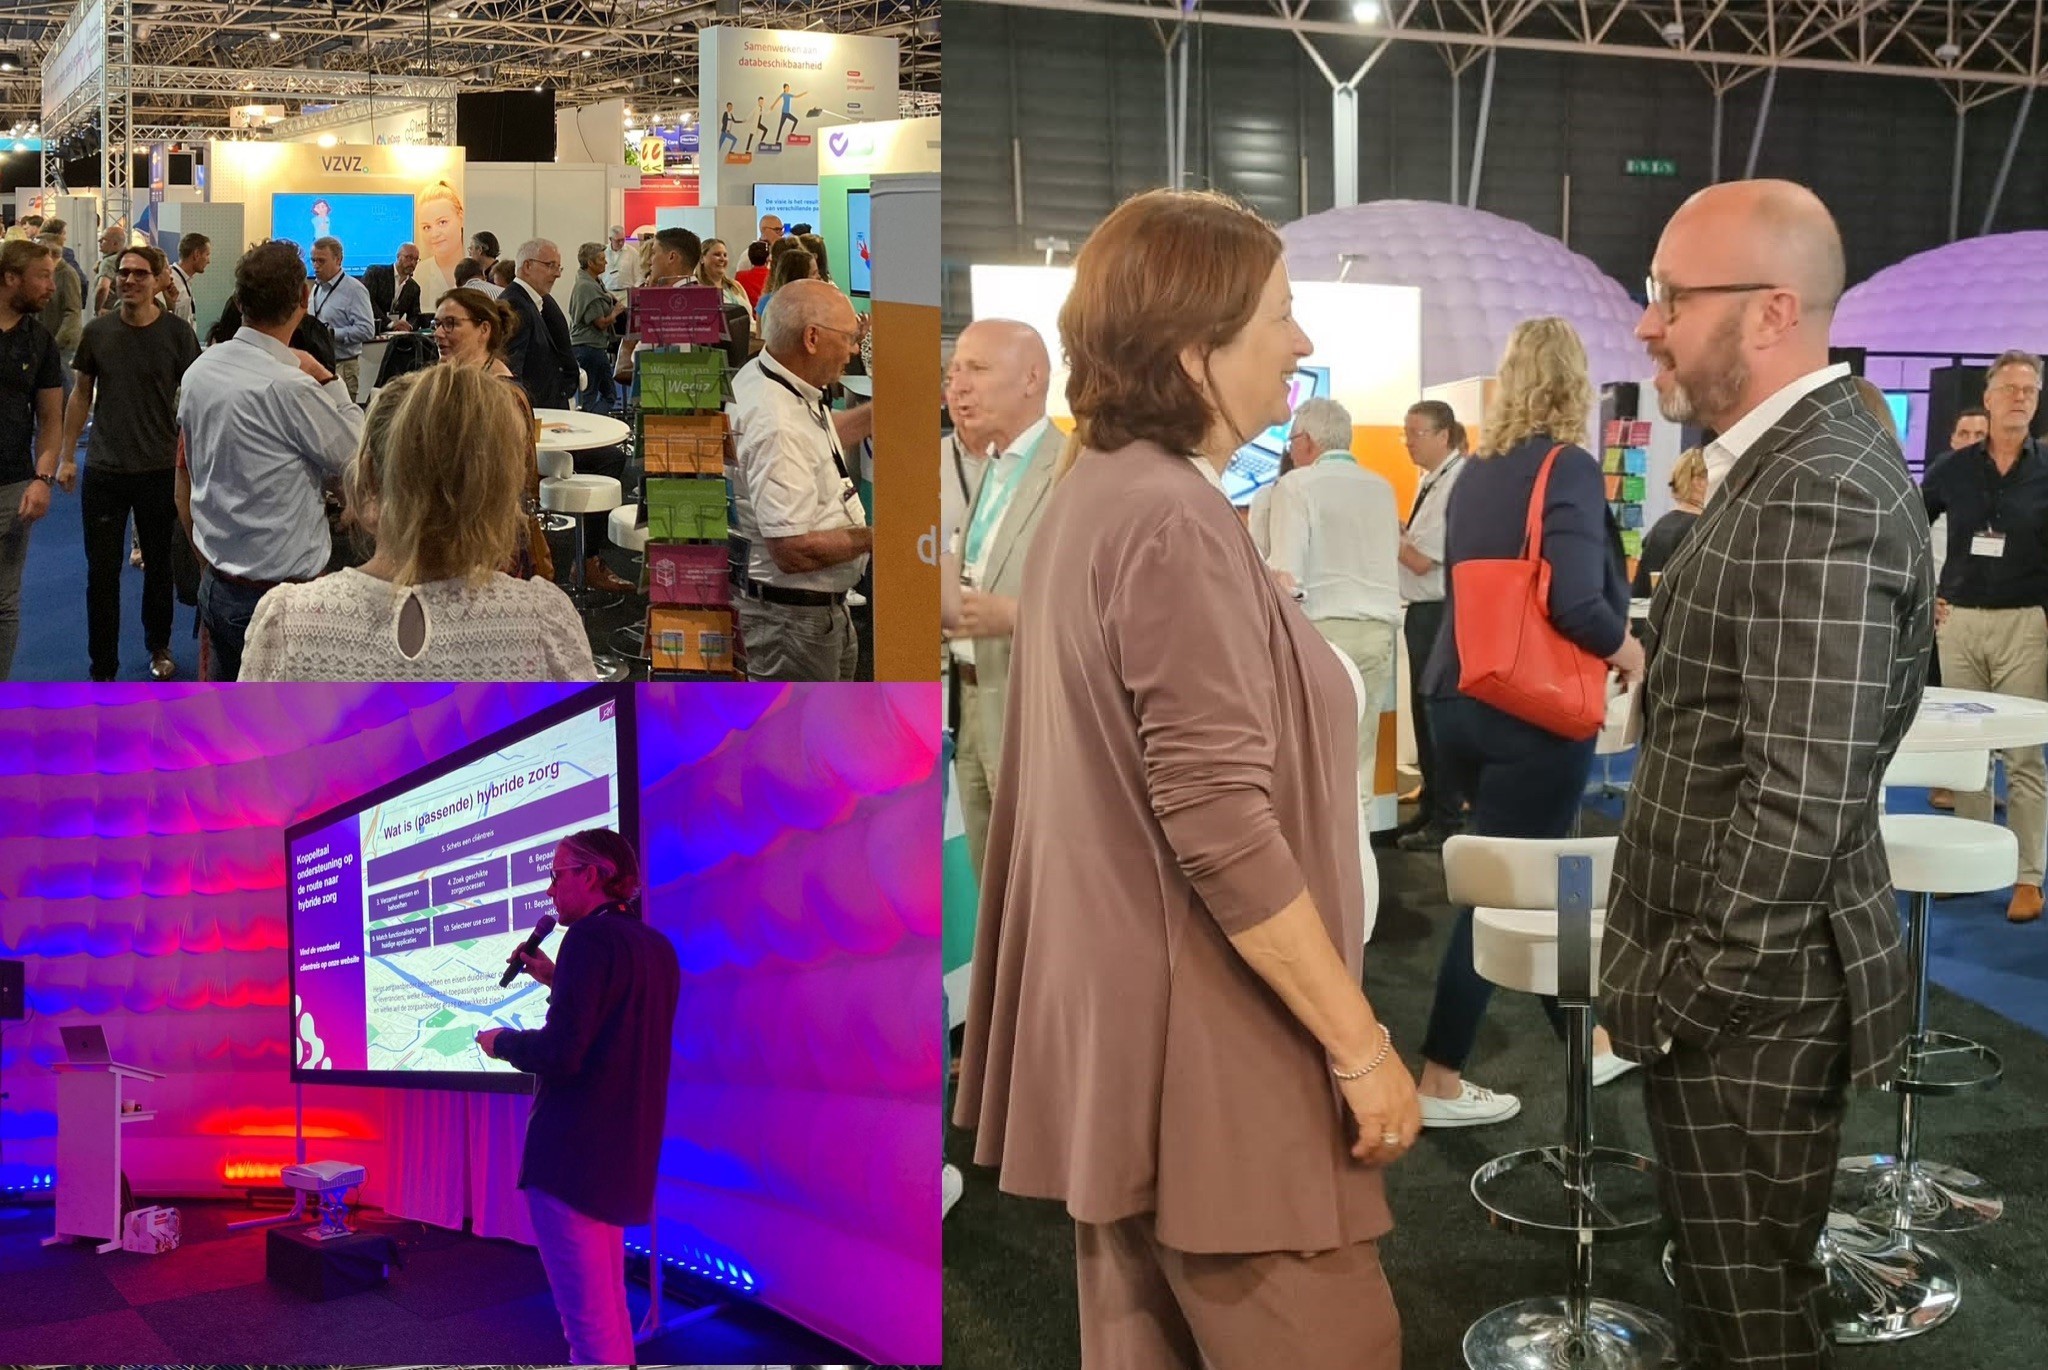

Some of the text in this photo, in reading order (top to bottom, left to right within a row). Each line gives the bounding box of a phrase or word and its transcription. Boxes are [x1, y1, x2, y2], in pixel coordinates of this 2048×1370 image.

[744, 42, 818, 54] Samenwerken aan
[738, 57, 823, 70] databeschikbaarheid
[650, 365, 688, 376] Werken
[668, 379, 711, 397] Wegiz
[384, 761, 560, 840] Wat is (passende) hybride zorg
[446, 839, 462, 852] Schets
[463, 838, 471, 847] een
[297, 843, 330, 865] Koppeltaal
[528, 849, 556, 864] 8. Bepaal
[297, 854, 353, 880] ondersteuning op
[453, 874, 464, 885] Zoek
[465, 868, 488, 884] geschikte
[298, 875, 339, 895] de route naar
[450, 880, 486, 896] zorgprocessen
[298, 892, 337, 912] hybride zorg
[524, 897, 554, 910] 11. Bepaal
[451, 920, 473, 931] Selecteer
[482, 916, 496, 924] cases
[299, 941, 341, 956] Vind de voorbeeld
[320, 961, 327, 970] op
[327, 959, 340, 967] onze
[340, 955, 360, 965] website
